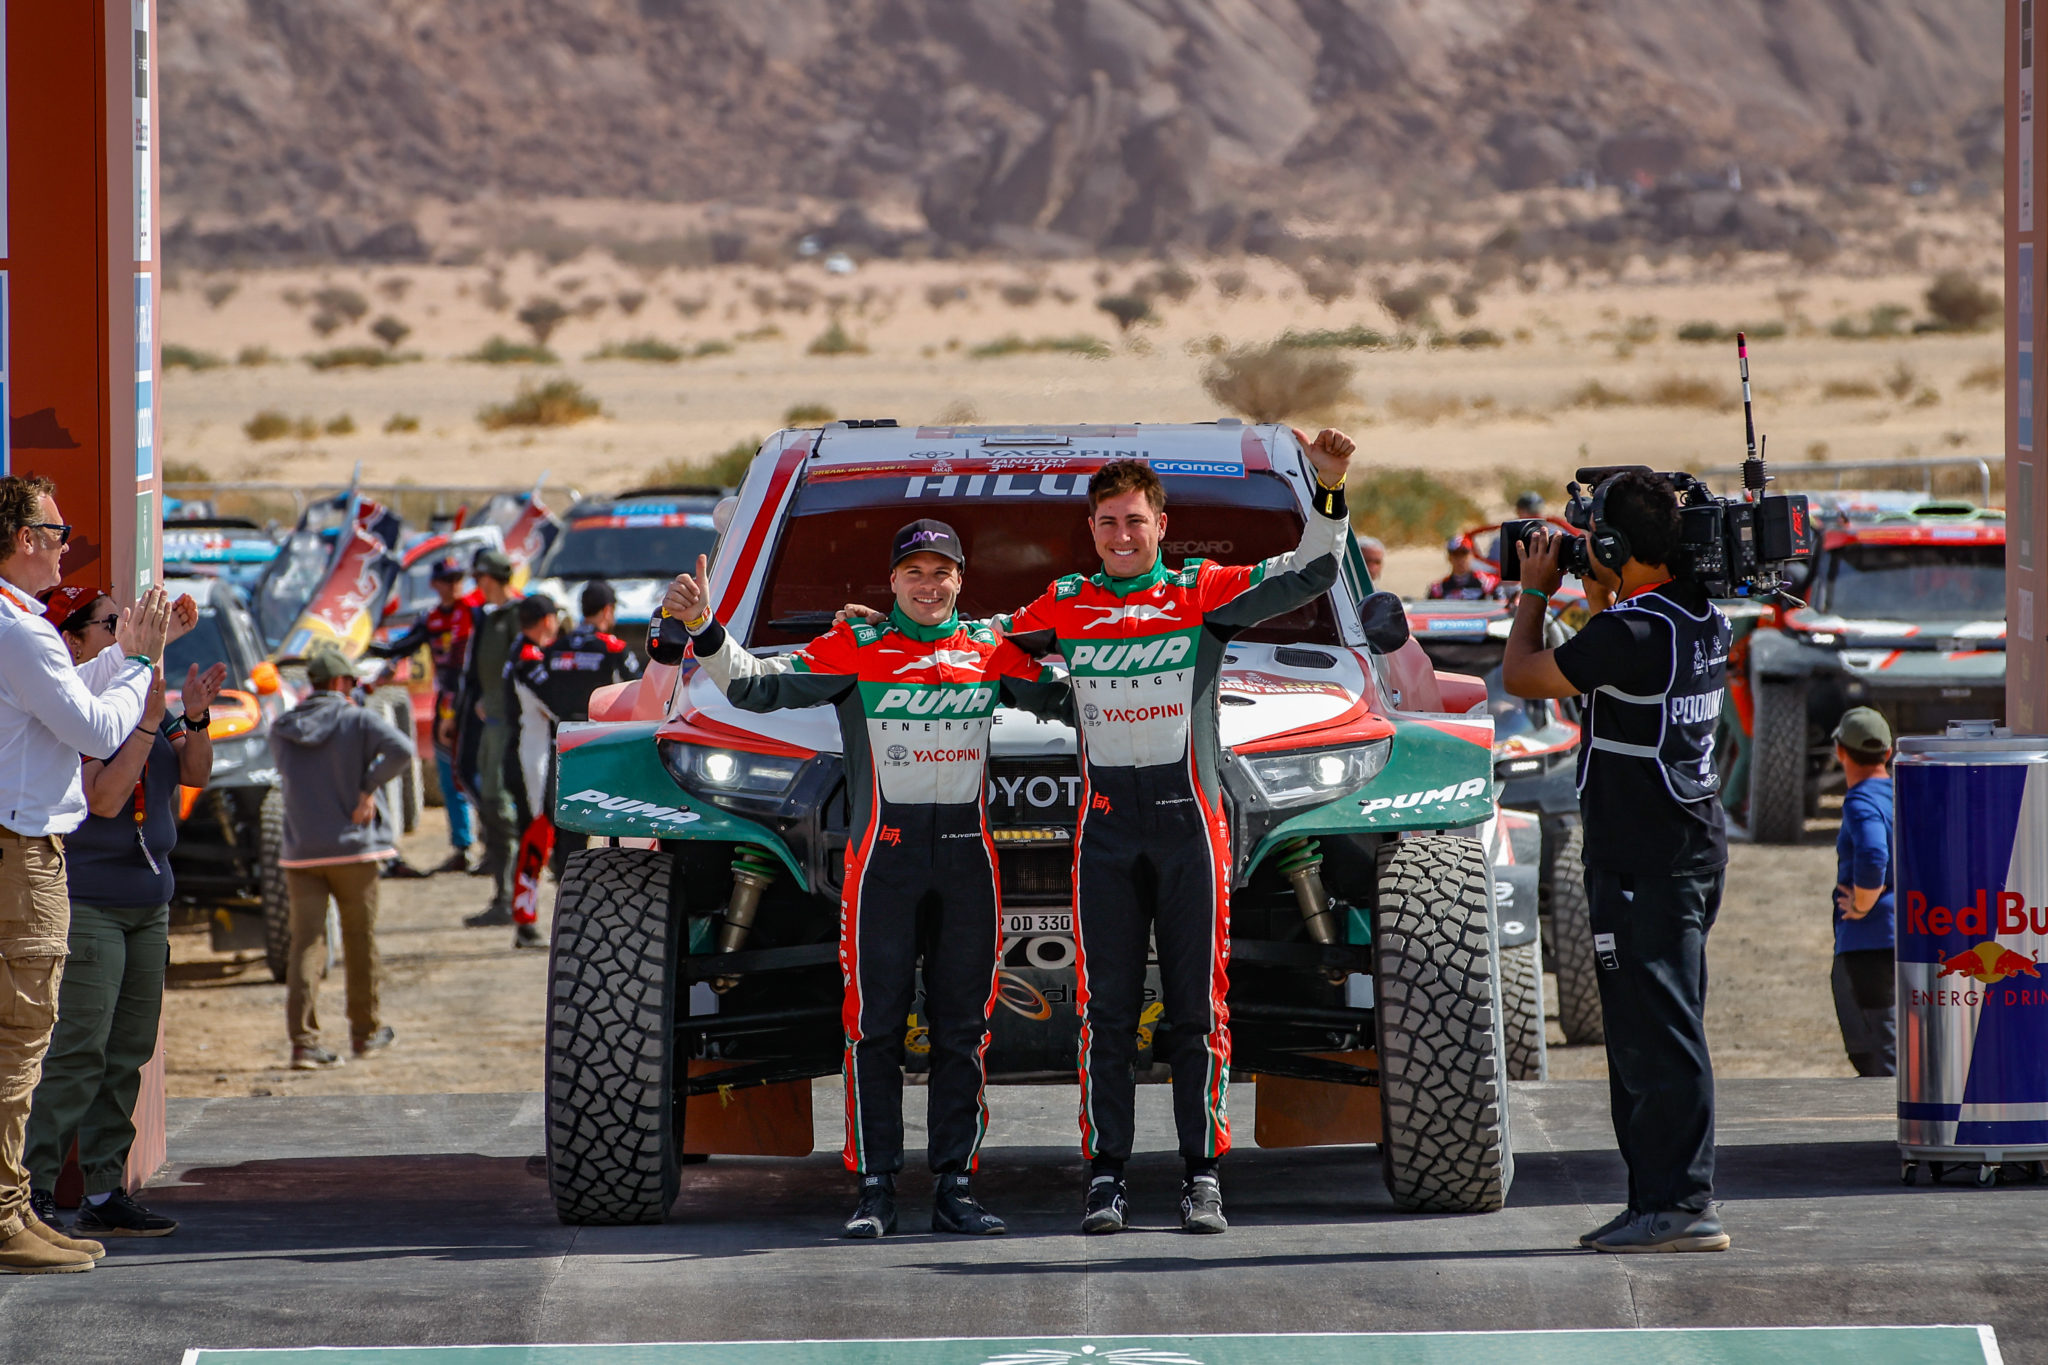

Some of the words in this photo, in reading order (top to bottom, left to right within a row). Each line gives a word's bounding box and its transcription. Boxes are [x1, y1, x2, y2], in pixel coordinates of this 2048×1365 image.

[981, 449, 1149, 458] YACOPINI
[989, 464, 1015, 472] 3RD
[1030, 464, 1066, 472] 17TH
[1154, 462, 1239, 473] aramco
[904, 474, 1089, 498] HILU
[1161, 540, 1234, 554] RECARO
[1070, 636, 1191, 671] PUMA
[874, 688, 993, 715] PUMA
[1103, 702, 1184, 723] YACOPINI
[881, 721, 984, 731] ENERGY
[913, 748, 981, 763] YACOPINI
[988, 775, 1082, 808] YOT
[1361, 777, 1487, 815] PUMA
[560, 803, 676, 831] ENERGY
[563, 789, 701, 824] PUMA
[1368, 797, 1491, 823] ENERGY
[1010, 916, 1033, 931] OD
[1038, 915, 1071, 931] 330
[1906, 889, 1987, 936] Red
[1996, 891, 2048, 936] Bu
[1911, 989, 1995, 1006] ENERGY
[2004, 989, 2048, 1006] DRIN
